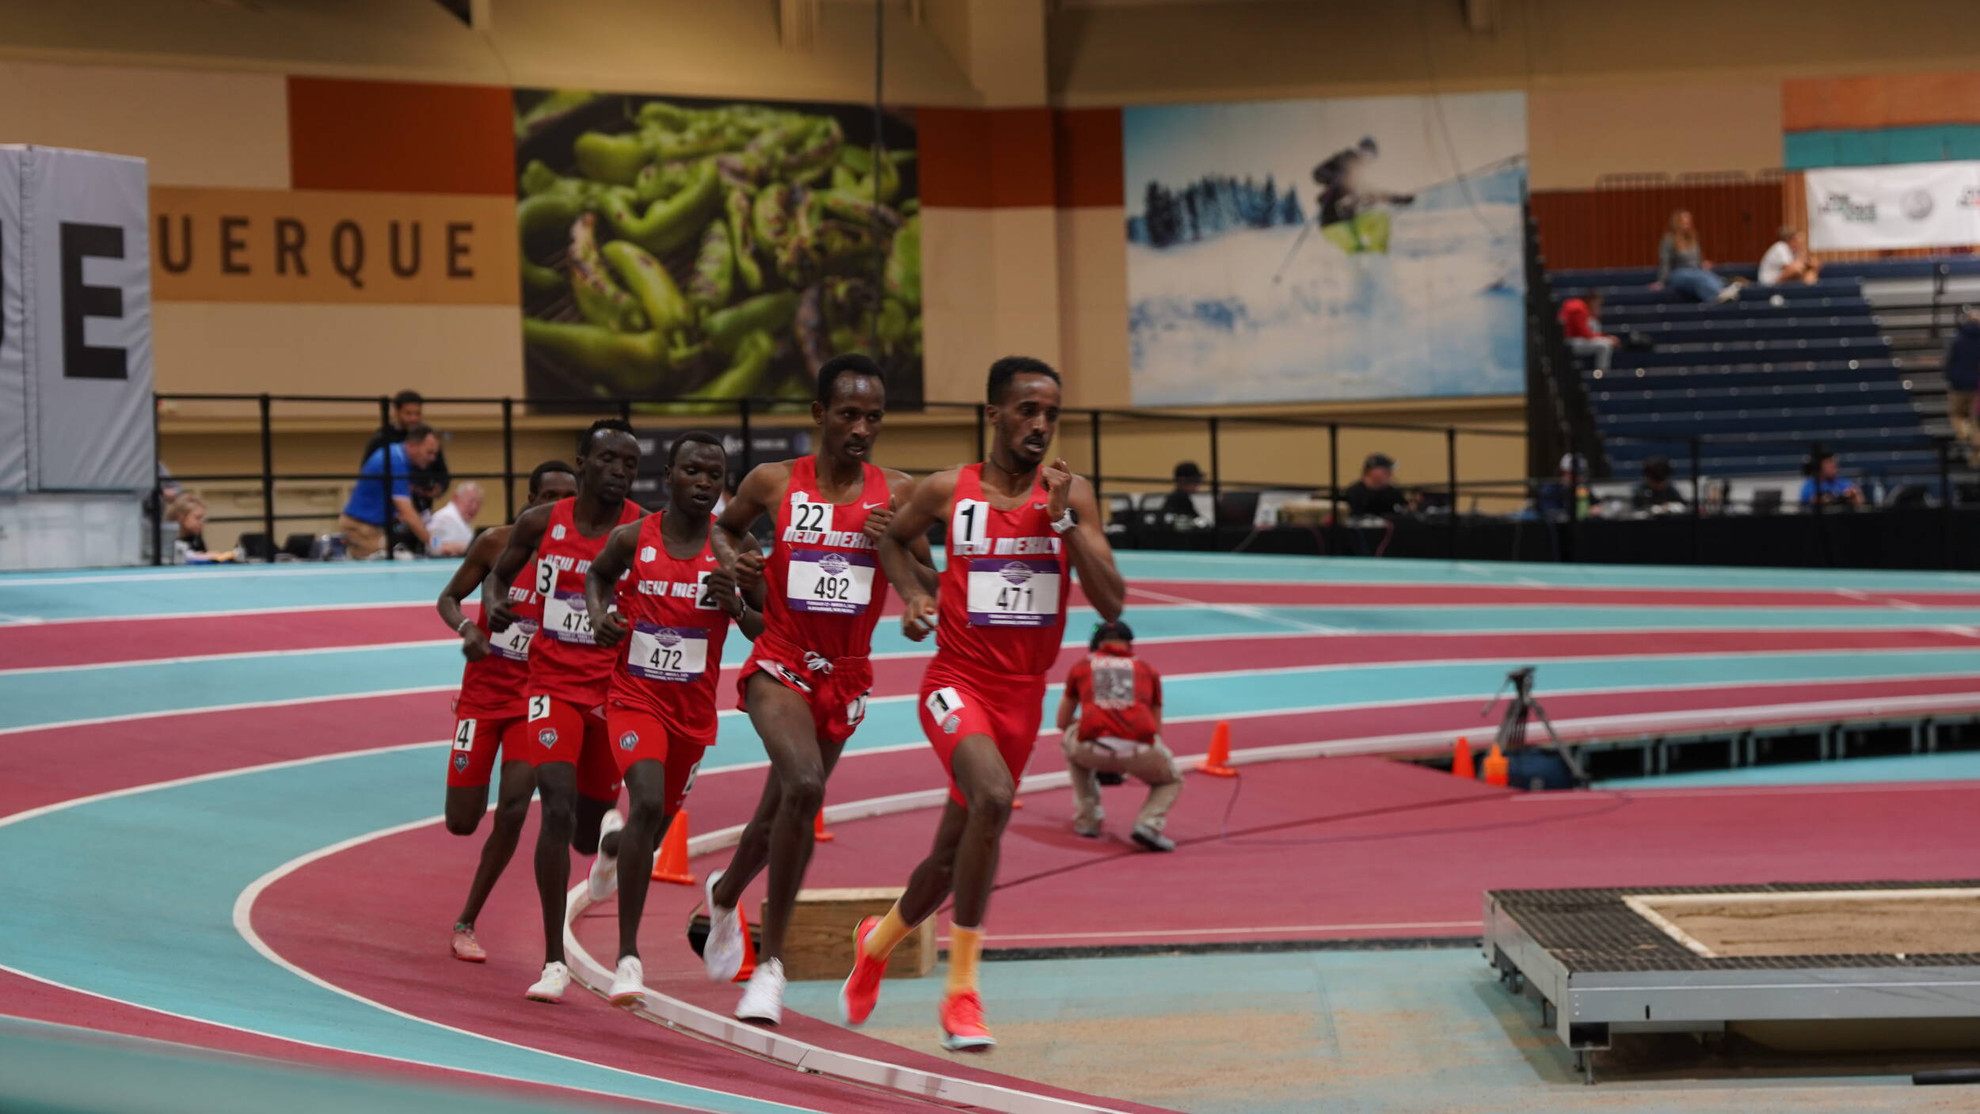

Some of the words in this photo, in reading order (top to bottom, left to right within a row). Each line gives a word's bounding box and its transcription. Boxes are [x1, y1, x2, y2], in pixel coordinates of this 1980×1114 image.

[157, 214, 475, 289] UERQUE
[796, 504, 824, 532] 22
[961, 504, 975, 541] 1
[539, 563, 553, 593] 3
[814, 576, 849, 600] 492
[996, 587, 1033, 612] 471
[563, 613, 592, 632] 473
[510, 634, 530, 652] 47
[650, 648, 682, 670] 472
[532, 695, 544, 718] 3
[457, 720, 470, 748] 4
